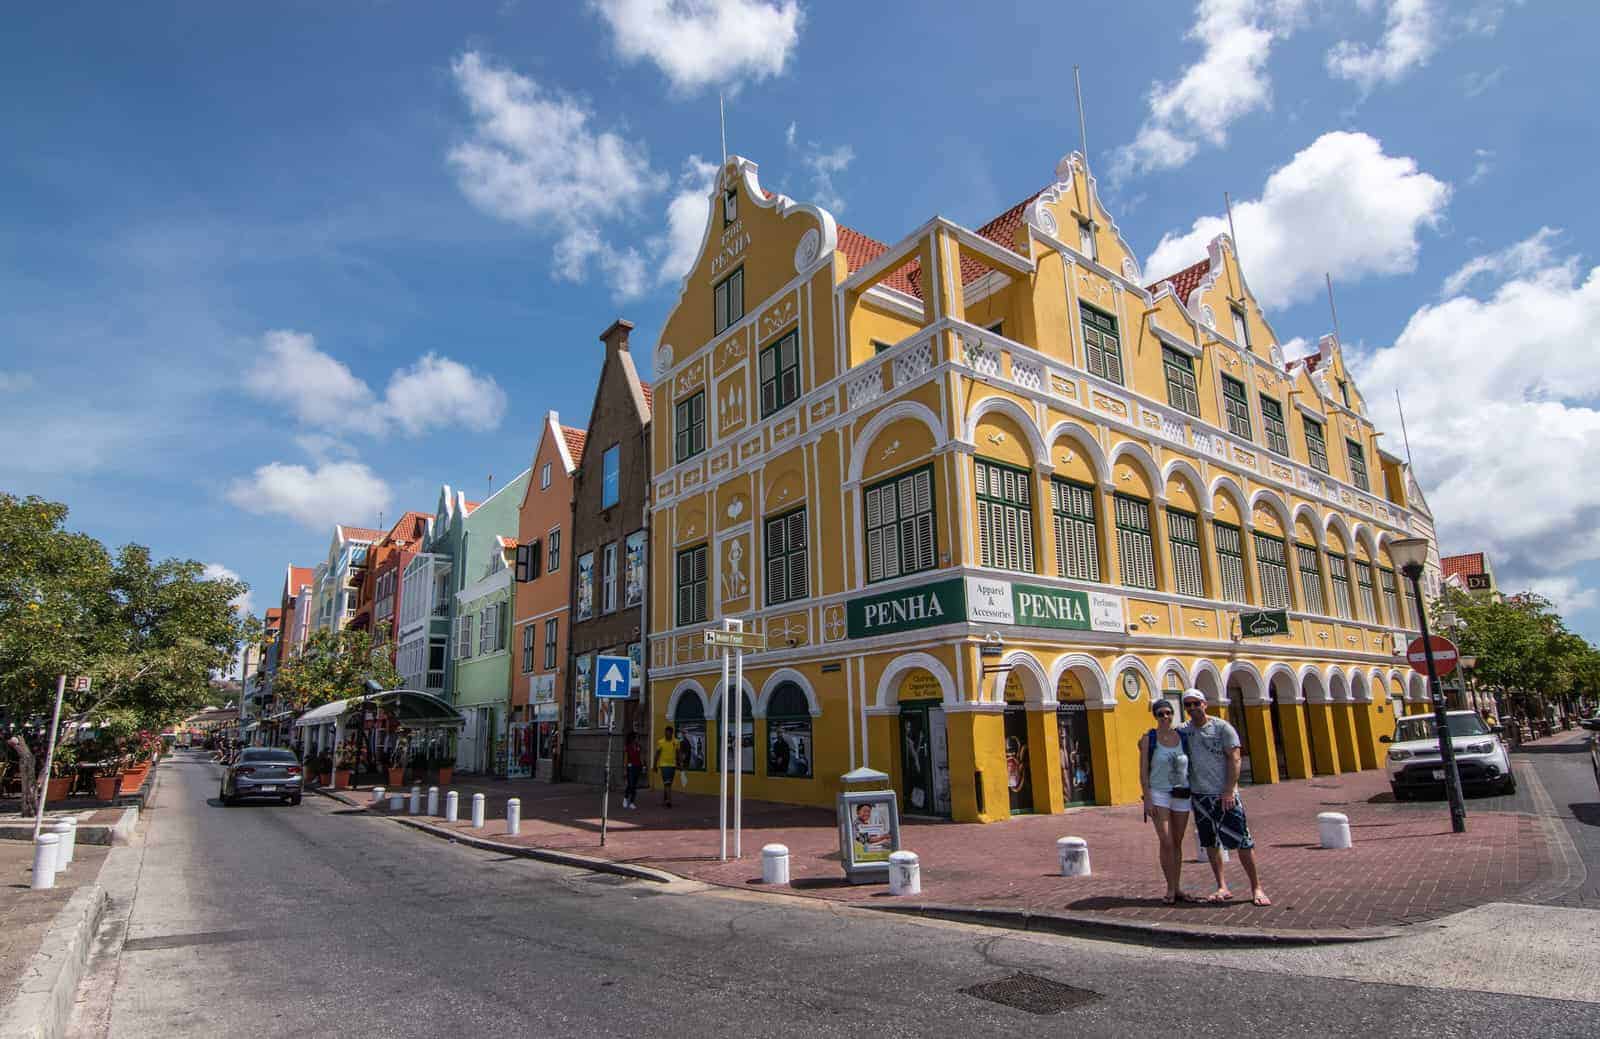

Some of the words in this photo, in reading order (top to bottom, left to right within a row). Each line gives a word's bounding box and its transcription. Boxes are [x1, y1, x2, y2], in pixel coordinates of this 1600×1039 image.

[711, 231, 751, 275] PENHA
[976, 584, 1005, 596] Apparel
[864, 591, 944, 628] PENHA
[971, 607, 1011, 619] Accessories
[1018, 591, 1086, 622] PENHA
